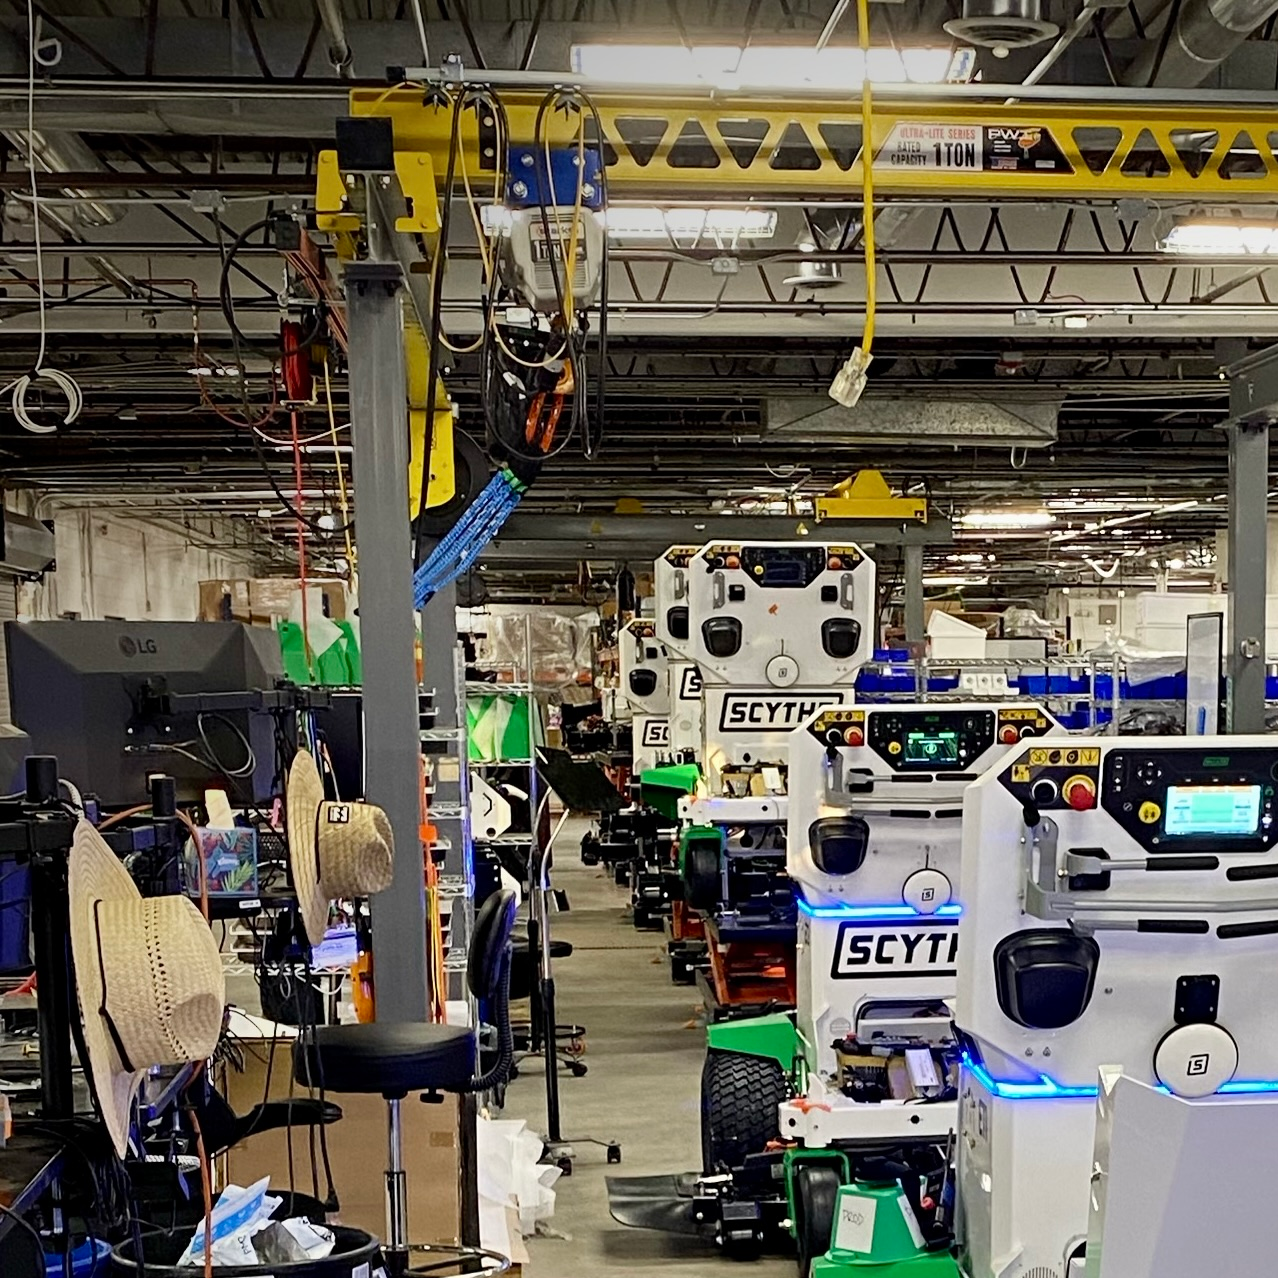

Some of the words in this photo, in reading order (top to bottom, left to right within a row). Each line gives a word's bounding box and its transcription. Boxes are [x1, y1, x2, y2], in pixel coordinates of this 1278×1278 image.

[900, 127, 944, 139] ULTRA-LITE
[948, 128, 976, 140] SERIES
[897, 141, 921, 153] RATED
[891, 153, 927, 166] CAPACITY
[136, 638, 158, 654] LG
[729, 702, 834, 723] SCYTH
